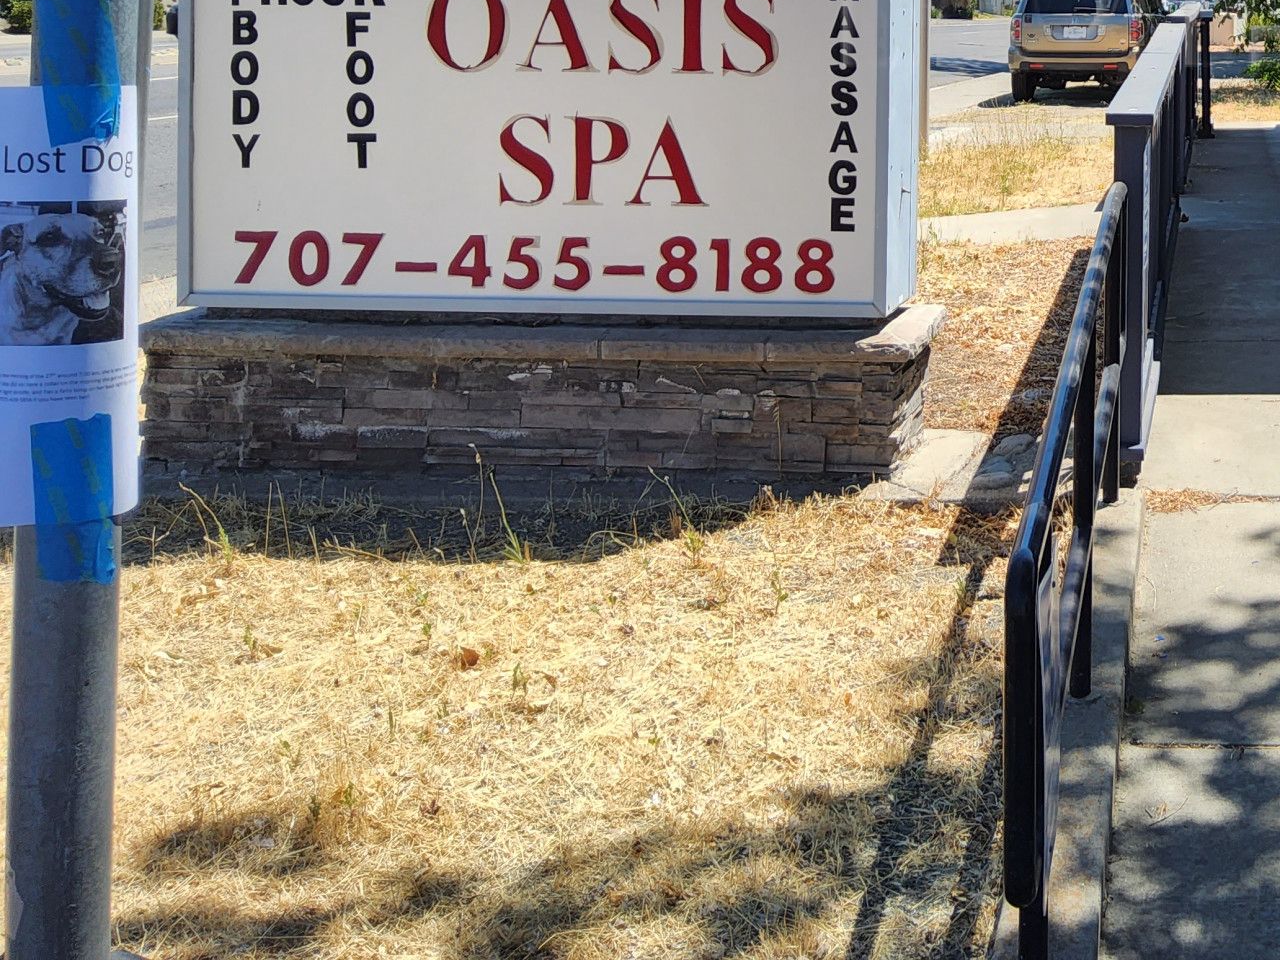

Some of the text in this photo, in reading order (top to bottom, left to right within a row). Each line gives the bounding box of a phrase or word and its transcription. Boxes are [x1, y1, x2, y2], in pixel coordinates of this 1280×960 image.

[230, 10, 260, 169] BODY
[345, 11, 377, 169] FOOT
[4, 145, 133, 178] Lost Dog
[499, 111, 710, 207] SPA
[234, 231, 835, 293] 707-455-8188
